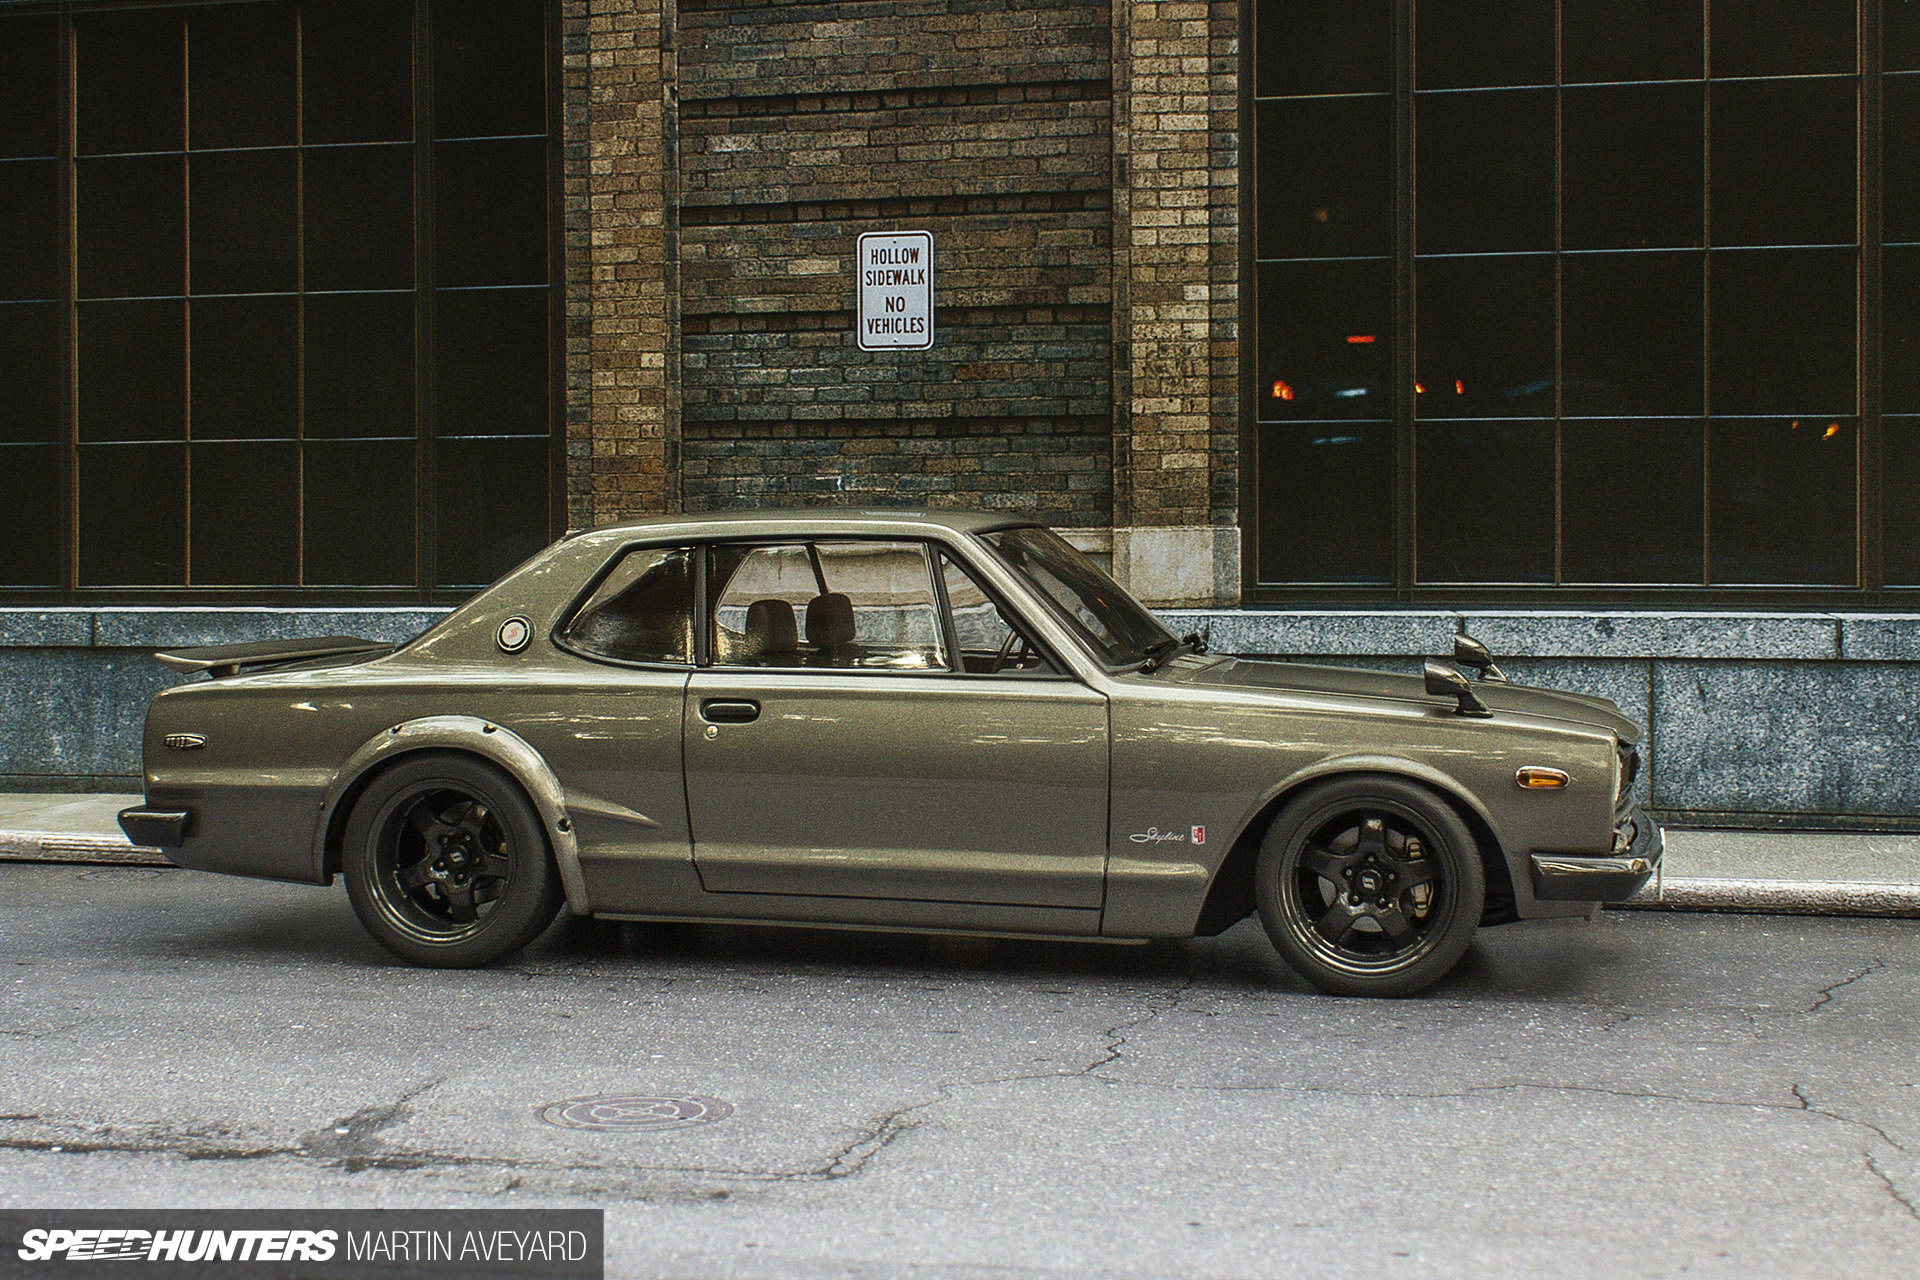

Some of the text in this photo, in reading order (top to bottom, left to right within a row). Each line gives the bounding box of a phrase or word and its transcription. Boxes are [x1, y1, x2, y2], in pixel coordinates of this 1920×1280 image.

[871, 248, 919, 265] HOLLOW
[865, 269, 925, 286] SIDEWALK
[885, 296, 906, 313] NO
[867, 317, 925, 334] VEHICLES
[1129, 826, 1185, 844] Skyline
